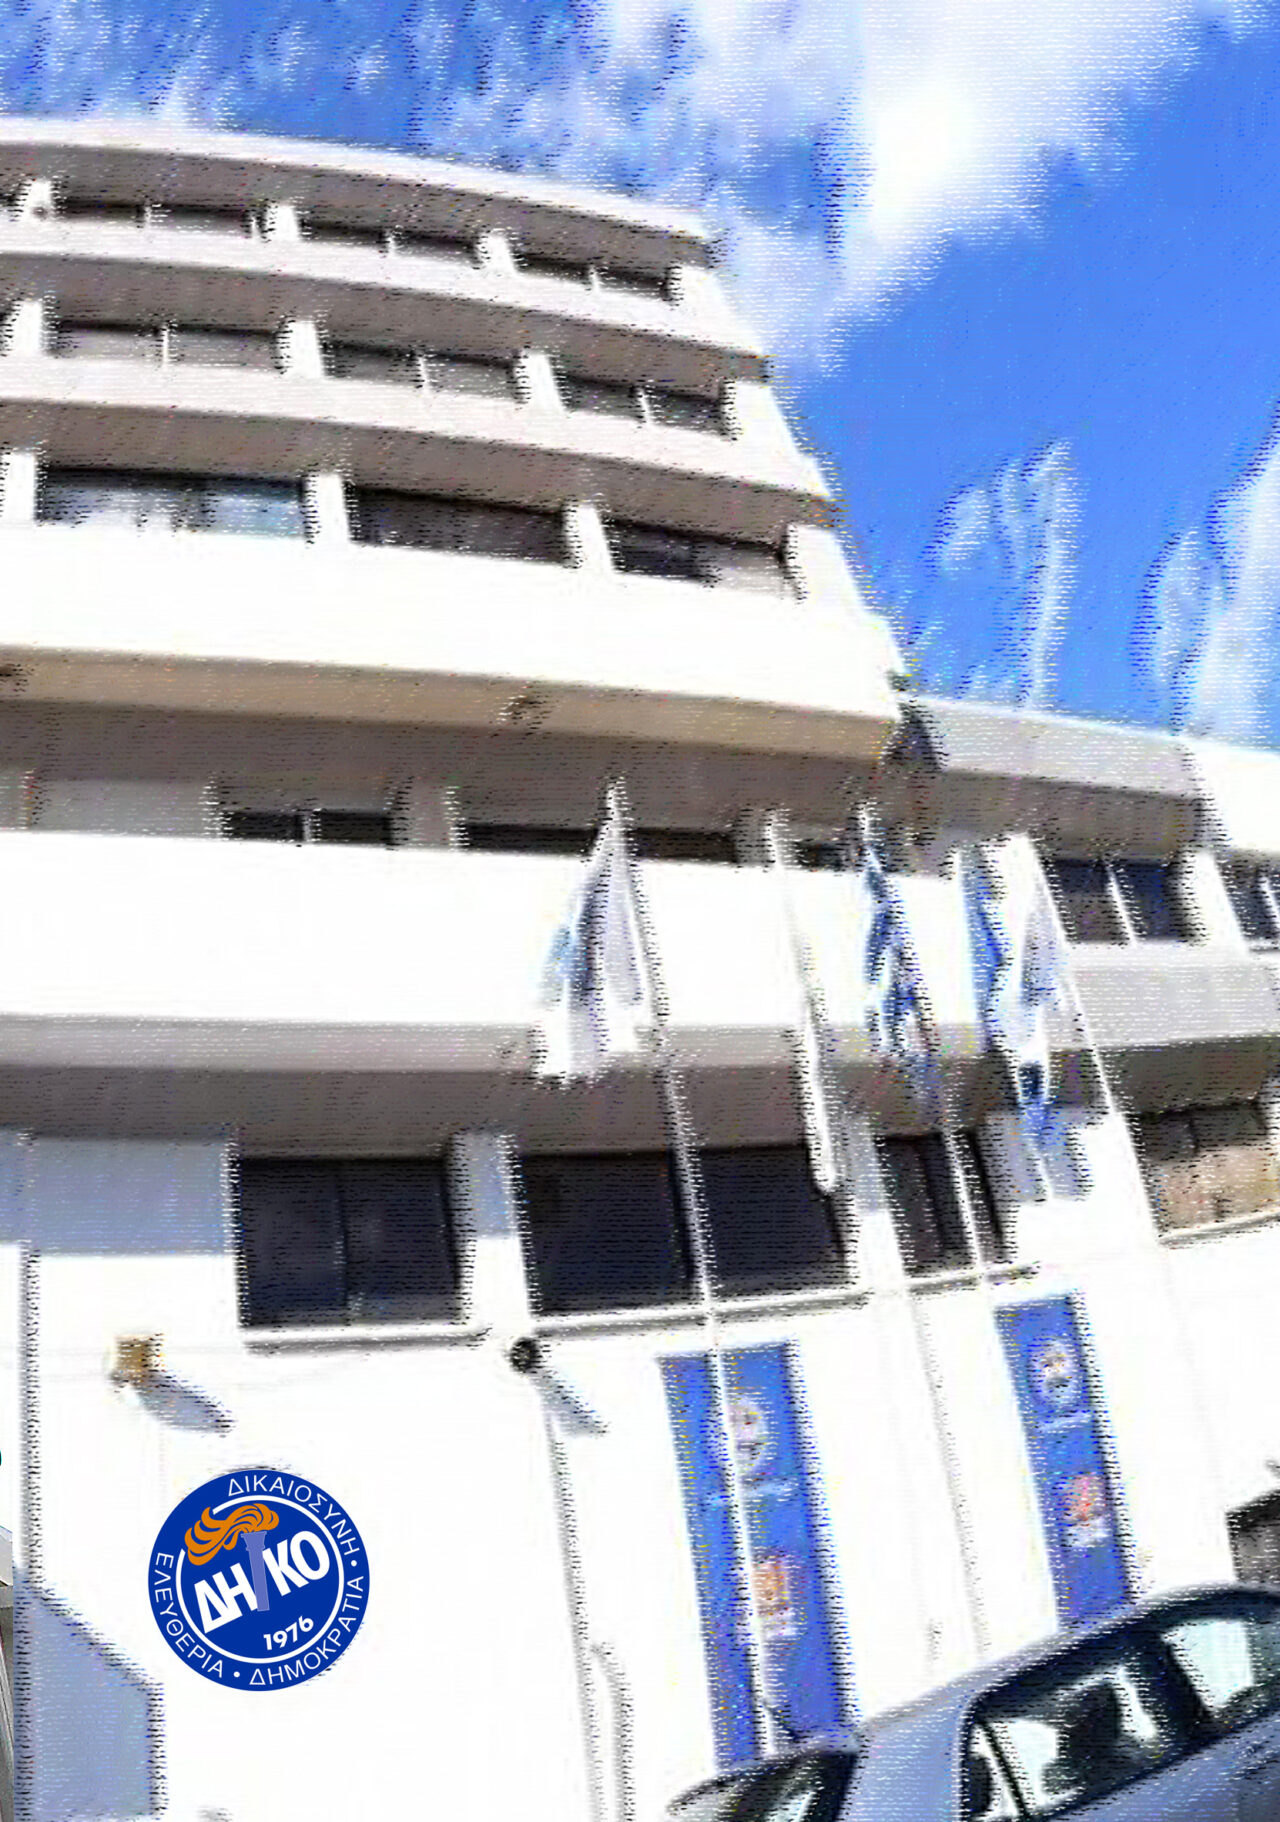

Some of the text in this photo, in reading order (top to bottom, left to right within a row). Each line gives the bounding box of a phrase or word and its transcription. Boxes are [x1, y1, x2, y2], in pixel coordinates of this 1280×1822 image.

[228, 1474, 360, 1555] ΔΙΚΑΙΟΣΥΝΗ
[154, 1552, 223, 1678] ΕΛΕΥΘΕΡΙΑ
[249, 1575, 364, 1685] ΔΗΜΟΚΡΑΤΙΑ
[263, 1615, 314, 1651] 1976
